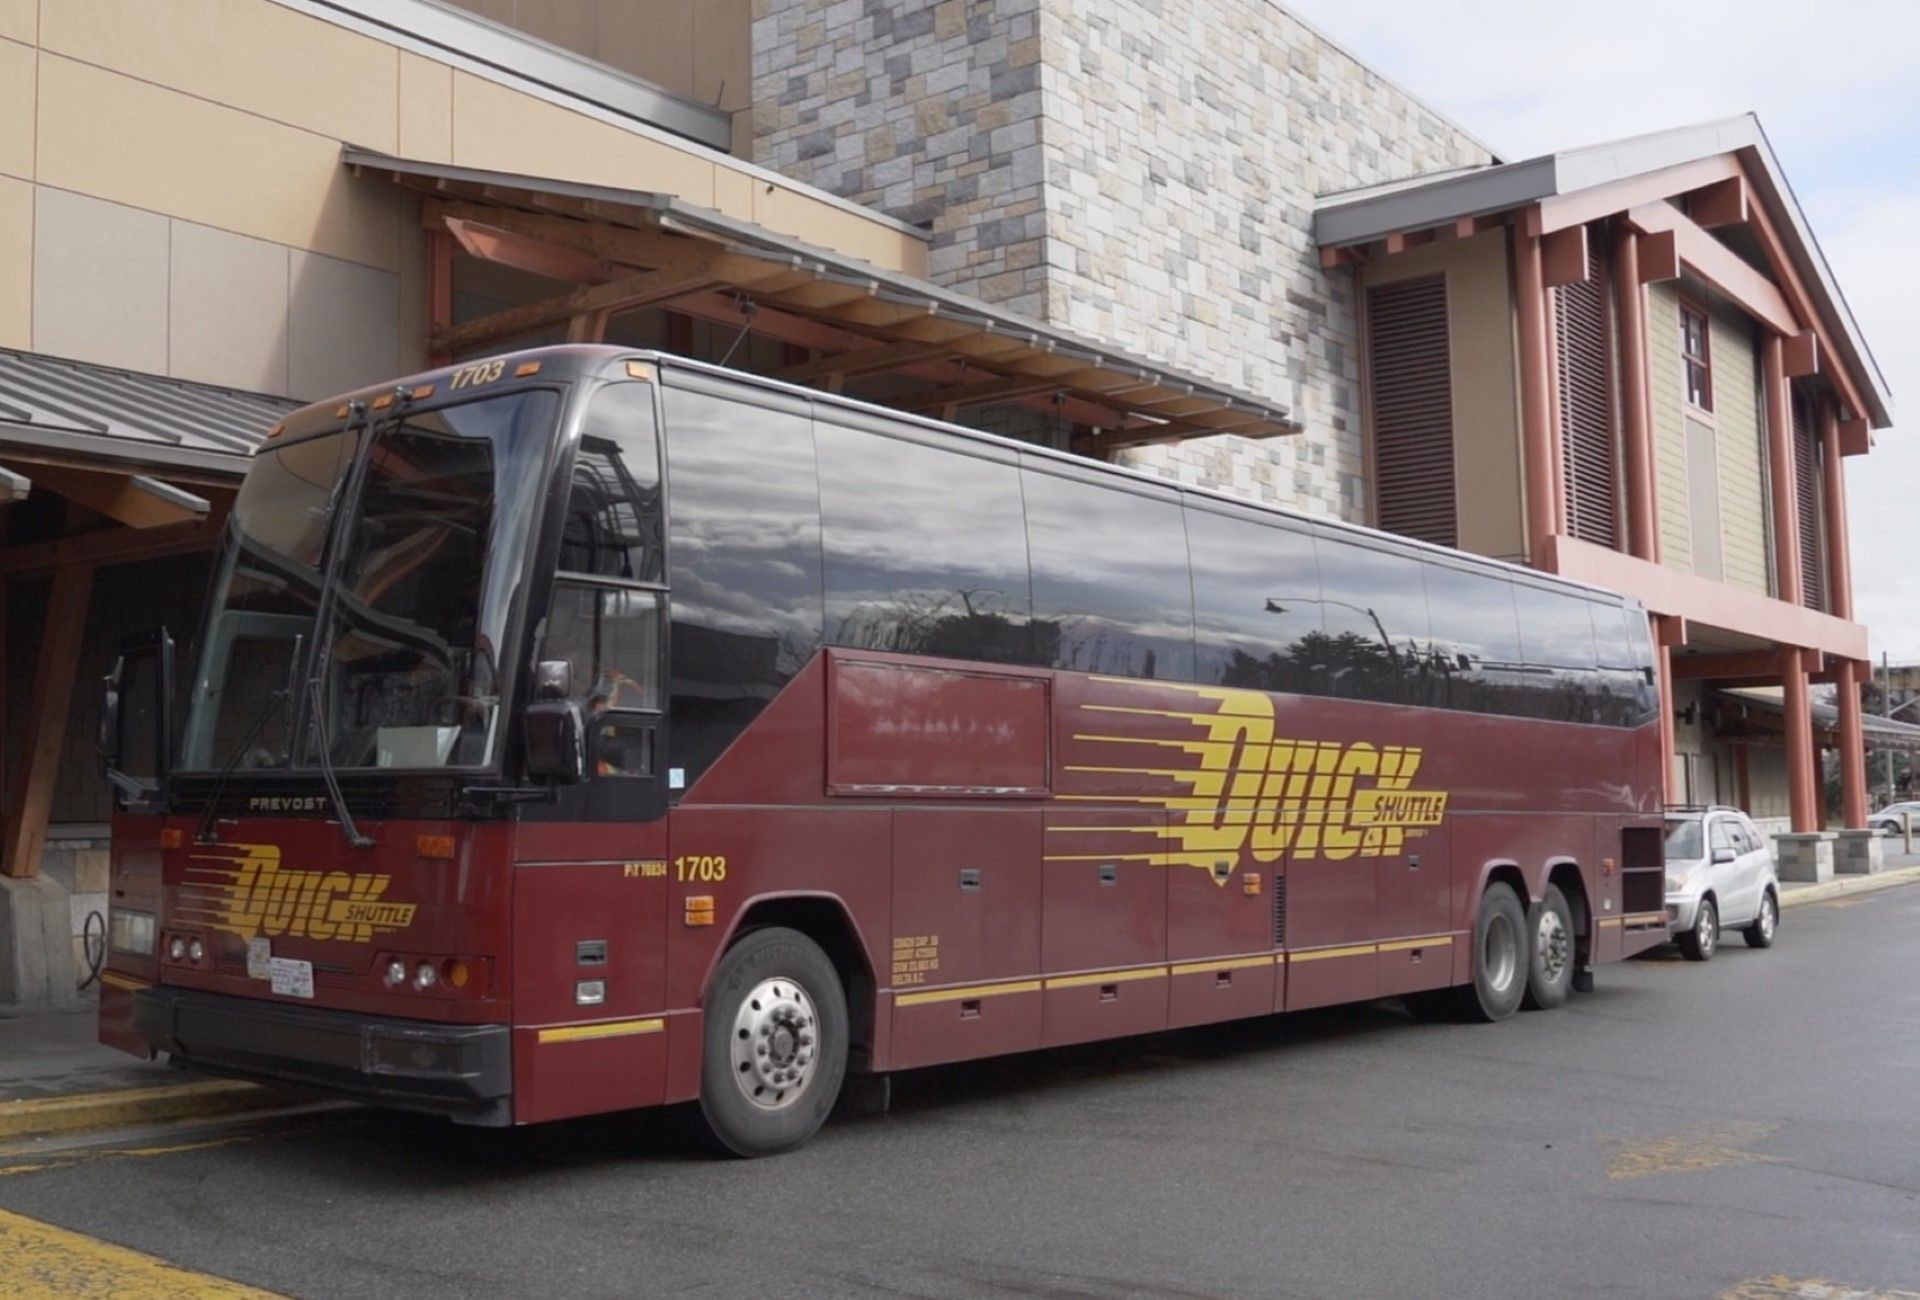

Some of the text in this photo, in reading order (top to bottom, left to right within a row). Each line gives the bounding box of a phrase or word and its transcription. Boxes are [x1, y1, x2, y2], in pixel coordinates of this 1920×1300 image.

[451, 360, 505, 389] 1703
[250, 797, 327, 810] PREVOST
[1372, 795, 1443, 822] SHUTTLE
[675, 856, 726, 882] 1703
[344, 904, 411, 923] SHUTTLE
